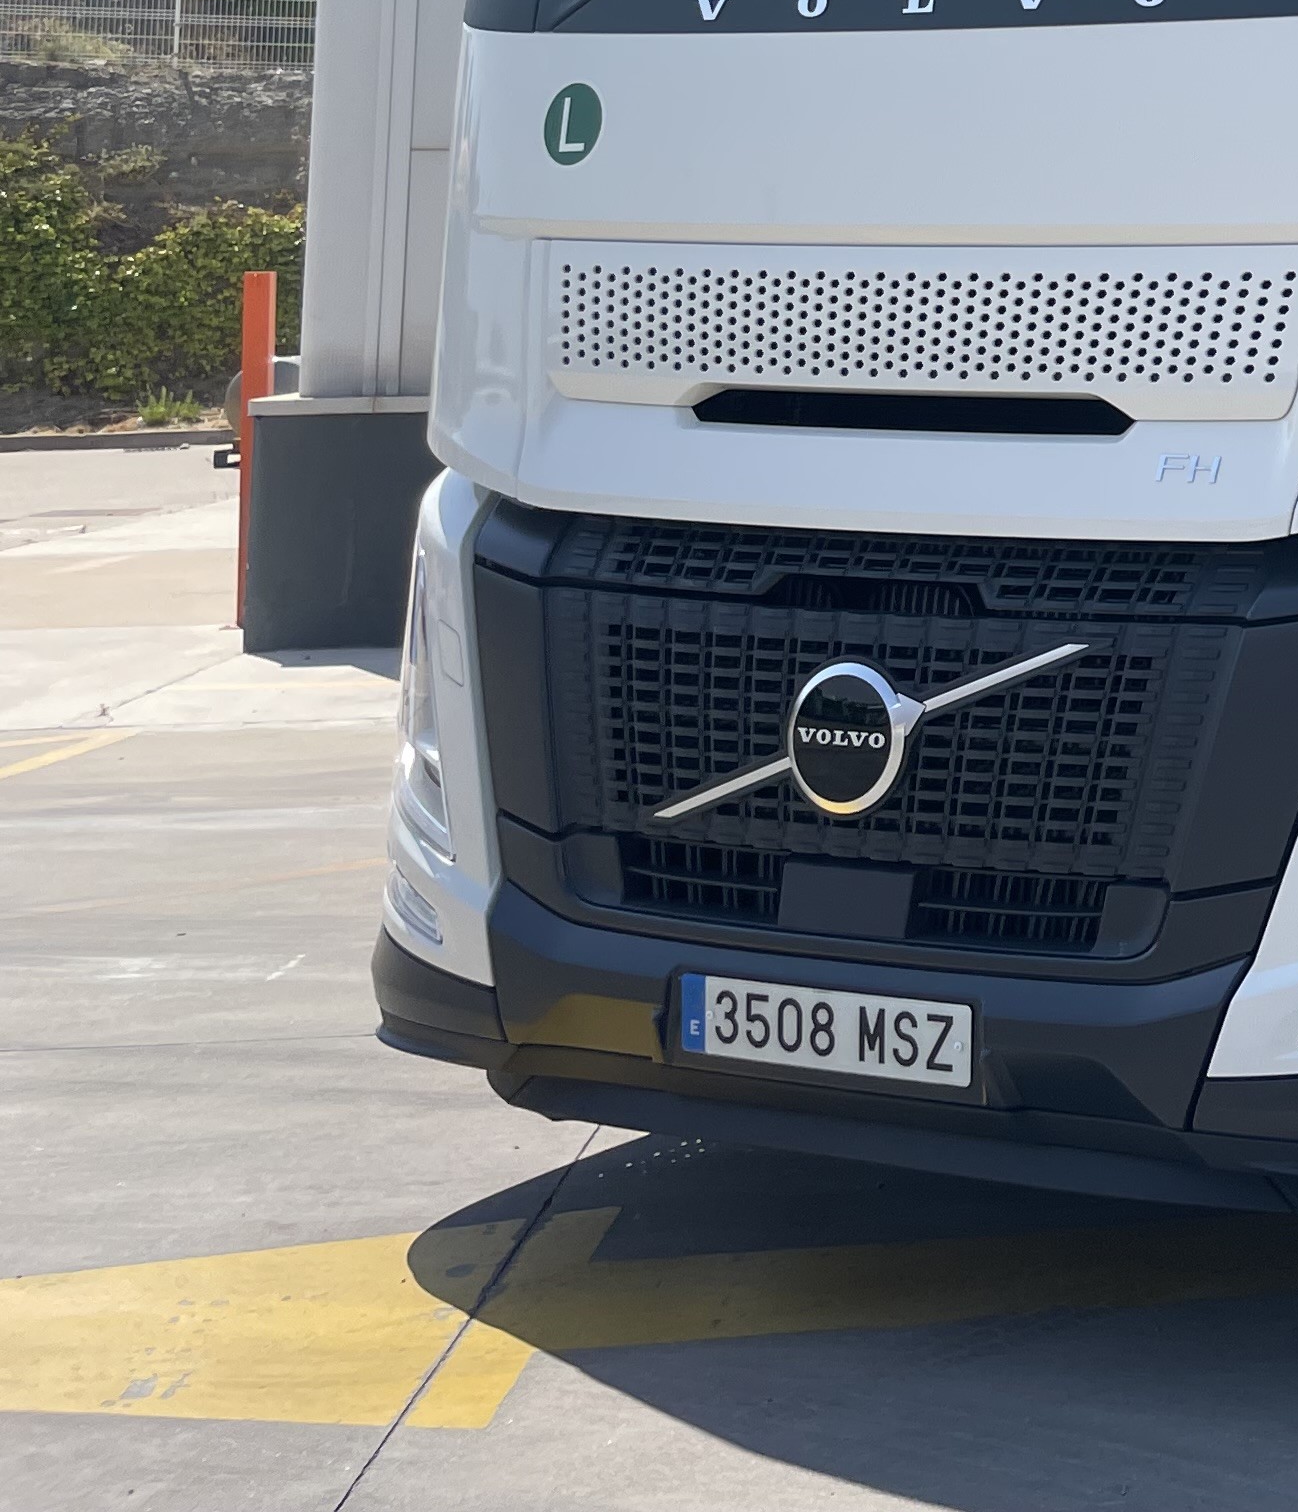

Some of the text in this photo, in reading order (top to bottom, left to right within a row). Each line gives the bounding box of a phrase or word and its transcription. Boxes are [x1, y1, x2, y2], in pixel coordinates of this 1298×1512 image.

[559, 97, 585, 152] L
[1155, 453, 1222, 484] FH
[797, 727, 886, 749] VOLVO
[690, 990, 954, 1072] E 3508 MSZ
